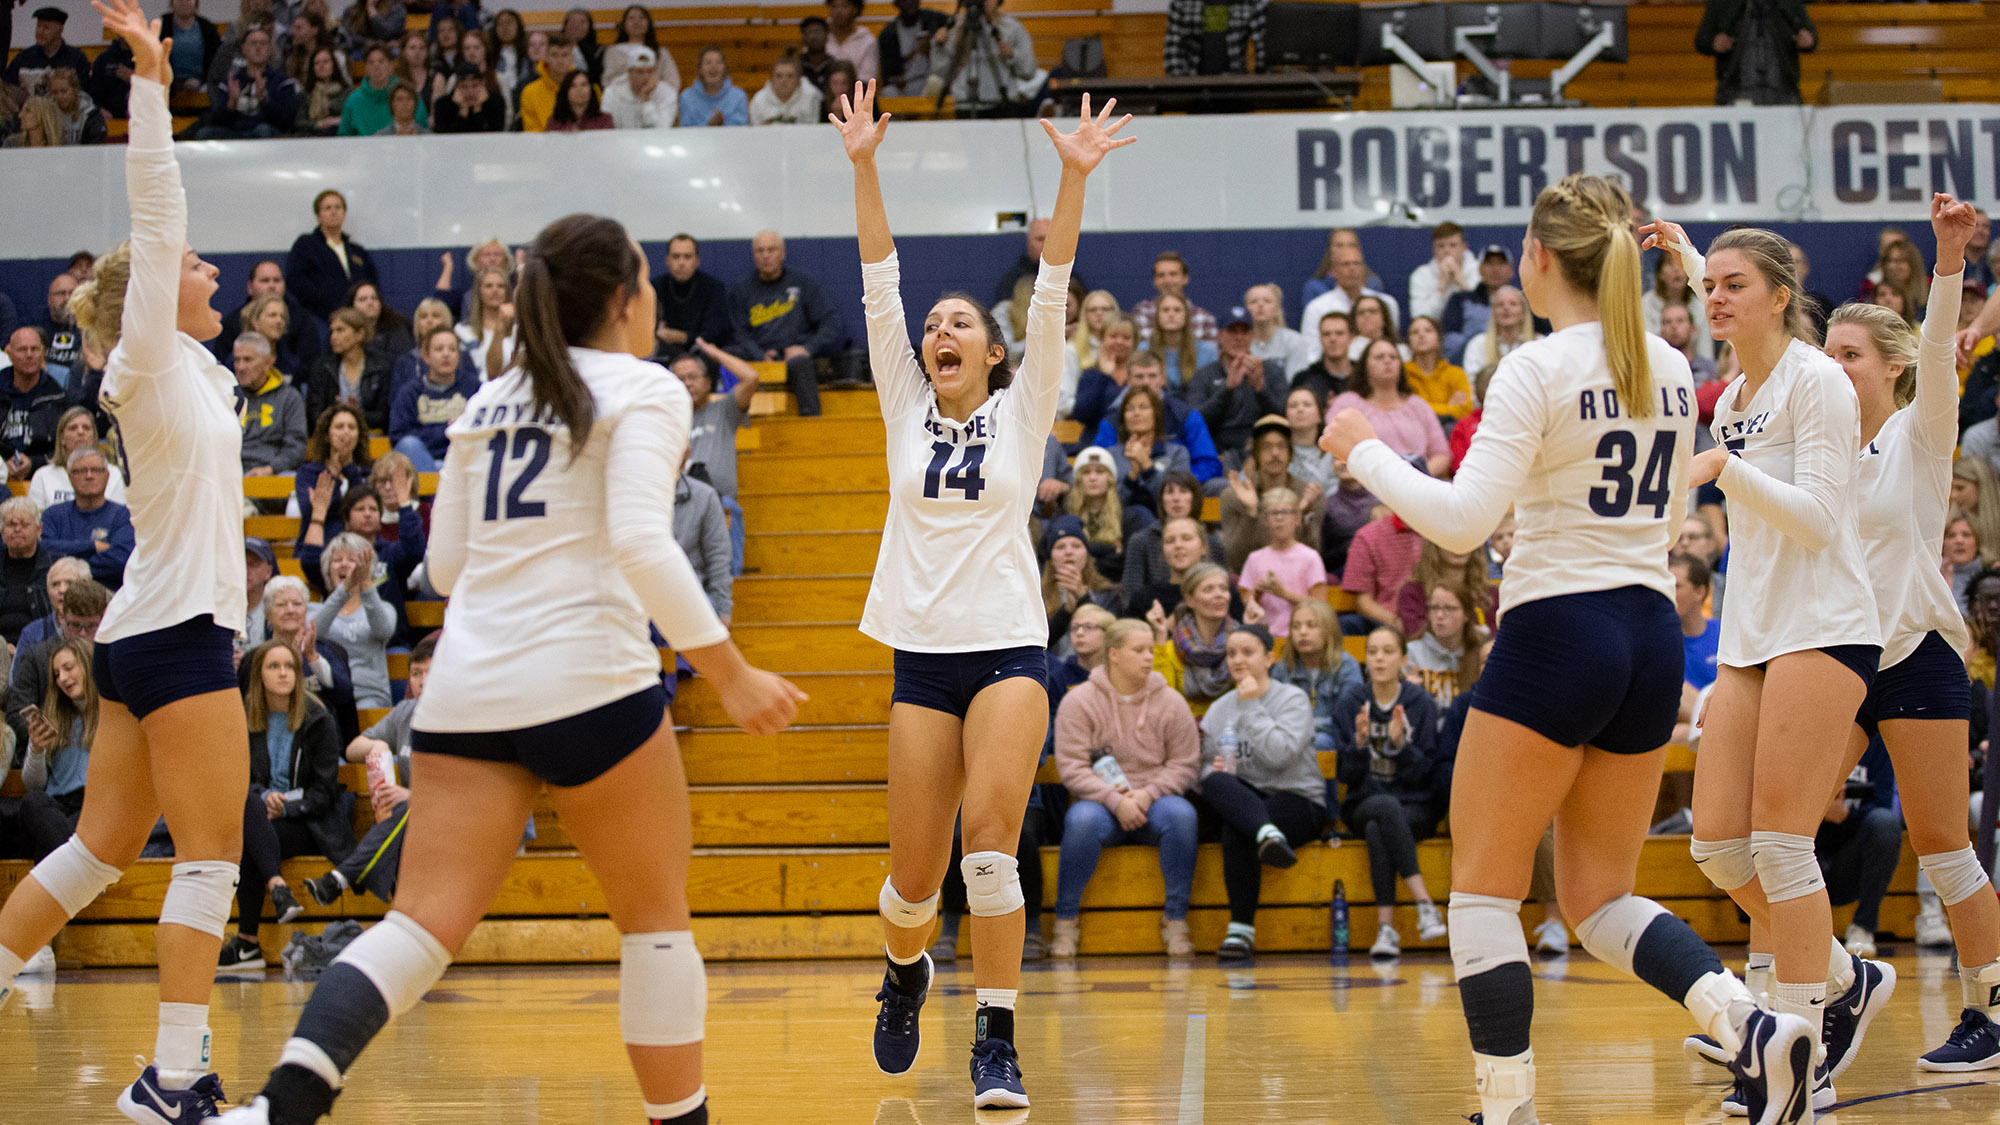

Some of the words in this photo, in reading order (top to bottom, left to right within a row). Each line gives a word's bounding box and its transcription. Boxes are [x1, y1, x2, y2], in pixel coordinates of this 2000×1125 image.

[1296, 122, 1758, 210] ROBERTSON
[1580, 387, 1689, 420] ROLS
[484, 427, 552, 521] 12
[923, 440, 987, 501] 14
[1588, 430, 1677, 519] 34
